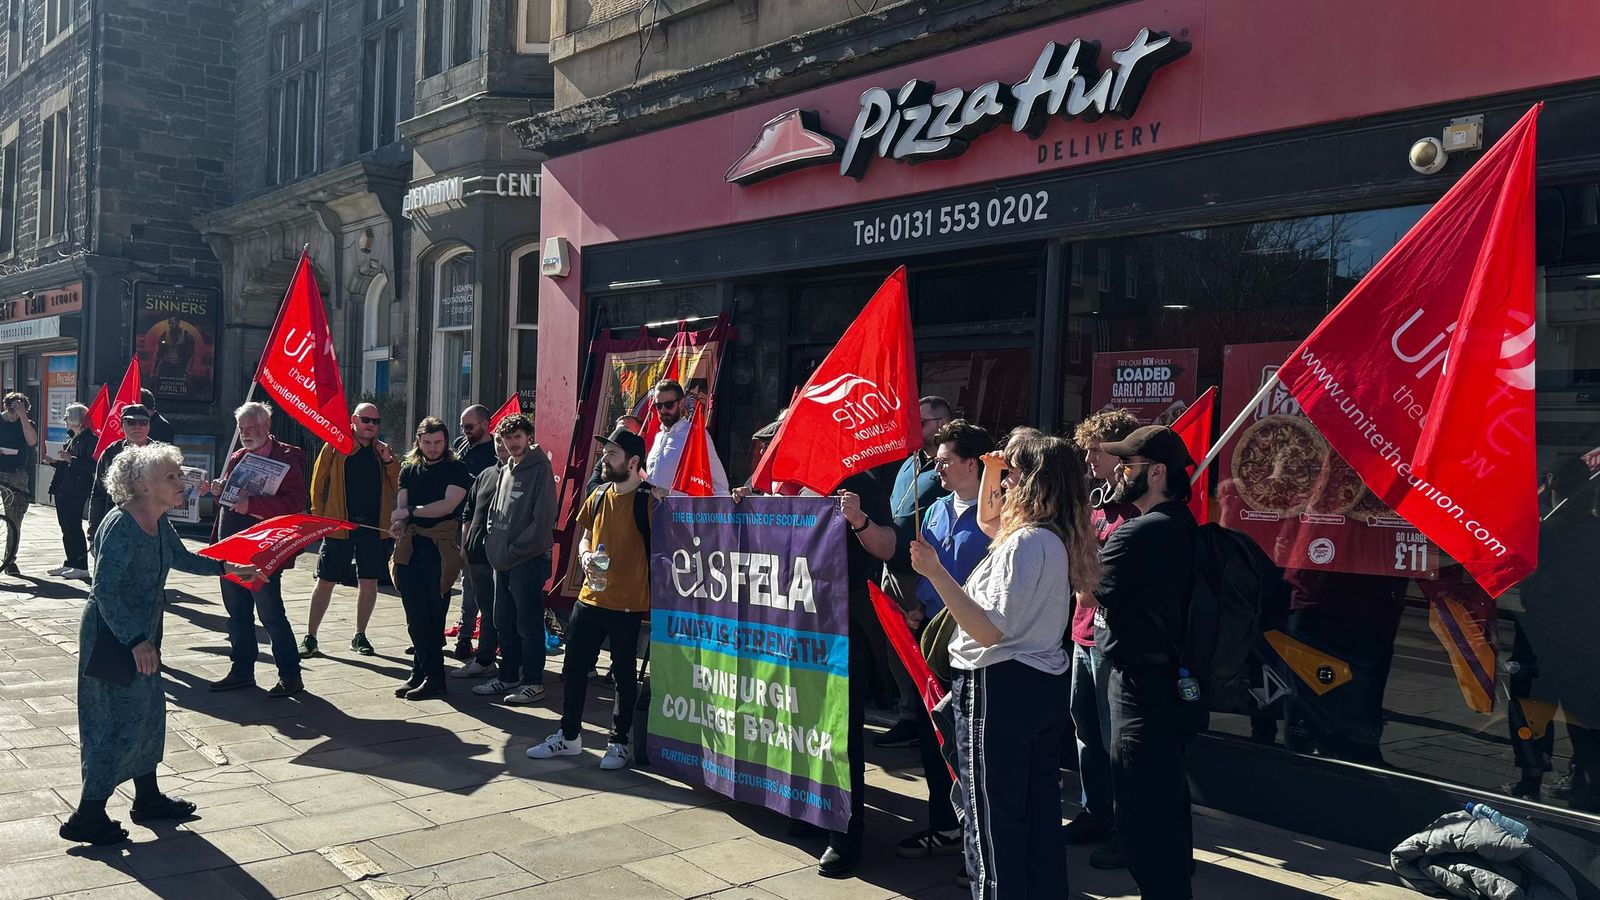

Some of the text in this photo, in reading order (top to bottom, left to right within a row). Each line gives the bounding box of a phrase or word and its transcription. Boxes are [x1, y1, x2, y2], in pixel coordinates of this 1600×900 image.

[840, 26, 1173, 180] Pizza Hut
[1038, 121, 1163, 164] DELIVERY
[853, 190, 1049, 247] Tel: 0131 553 0202
[145, 297, 207, 315] SINNERS
[1112, 381, 1175, 398] GARLIC BREAD
[1116, 366, 1172, 382] LOADED
[1300, 346, 1508, 558] www.unitetheunion.com
[671, 511, 685, 523] THE
[763, 513, 775, 526] OF
[775, 513, 817, 528] SCOTLAND
[1395, 531, 1428, 543] GO LARGE
[1394, 543, 1428, 571] £11
[716, 623, 730, 646] IS
[692, 664, 799, 713] EDINBURGH
[662, 693, 833, 762] COLLEGE BRANCH
[661, 748, 698, 767] FURTHER
[778, 782, 832, 811] ASSOCIATION
